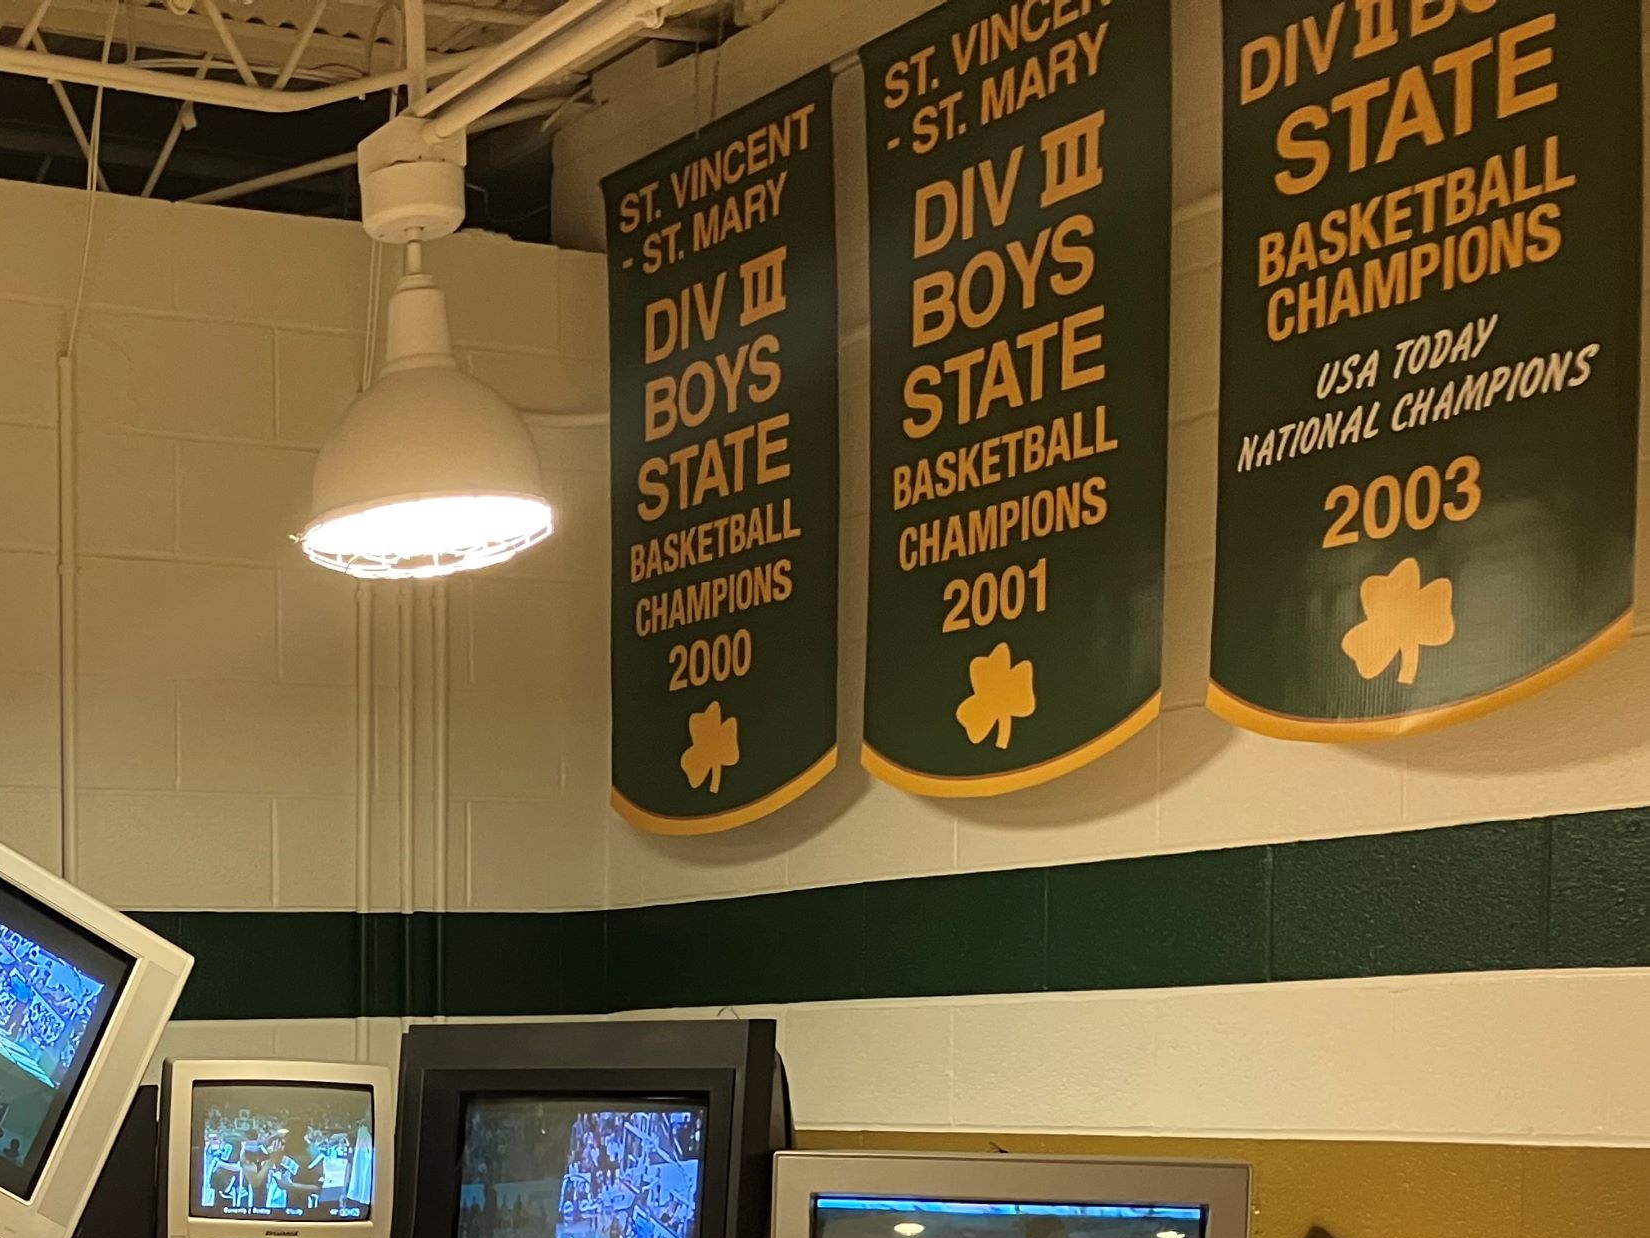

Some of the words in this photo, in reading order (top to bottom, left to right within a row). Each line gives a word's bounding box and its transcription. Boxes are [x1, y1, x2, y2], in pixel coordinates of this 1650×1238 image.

[884, 46, 940, 109] ST.
[911, 91, 968, 155] ST.
[980, 21, 1110, 126] MARY
[1240, 1, 1346, 106] DIV
[1274, 13, 1559, 195] STATE
[620, 181, 663, 234] ST.
[670, 103, 815, 209] VINCENT
[642, 222, 685, 275] ST.
[693, 170, 788, 252] MARY
[913, 145, 1024, 260] DIV
[1040, 109, 1106, 209] III
[1258, 135, 1577, 288] BASKETBALL
[644, 271, 727, 365] DIV
[739, 245, 788, 328] III
[912, 213, 1096, 349] BOYS
[1266, 202, 1562, 343] CHAMPIONS
[644, 333, 782, 443] BOYS
[902, 305, 1106, 440] STATE
[1236, 401, 1382, 473] NATIONAL
[1390, 343, 1602, 434] CHAMPIONS
[1315, 349, 1380, 400] USA
[1392, 313, 1499, 380] TODAY
[637, 412, 791, 523] STATE
[893, 404, 1119, 512] BASKETBALL
[1321, 454, 1483, 550] 2003
[630, 498, 802, 583] BASKETBALL
[898, 476, 1108, 573] CHAMPIONS
[635, 559, 793, 638] CHAMPIONS
[941, 557, 1048, 634] 2001
[668, 629, 752, 692] 2000
